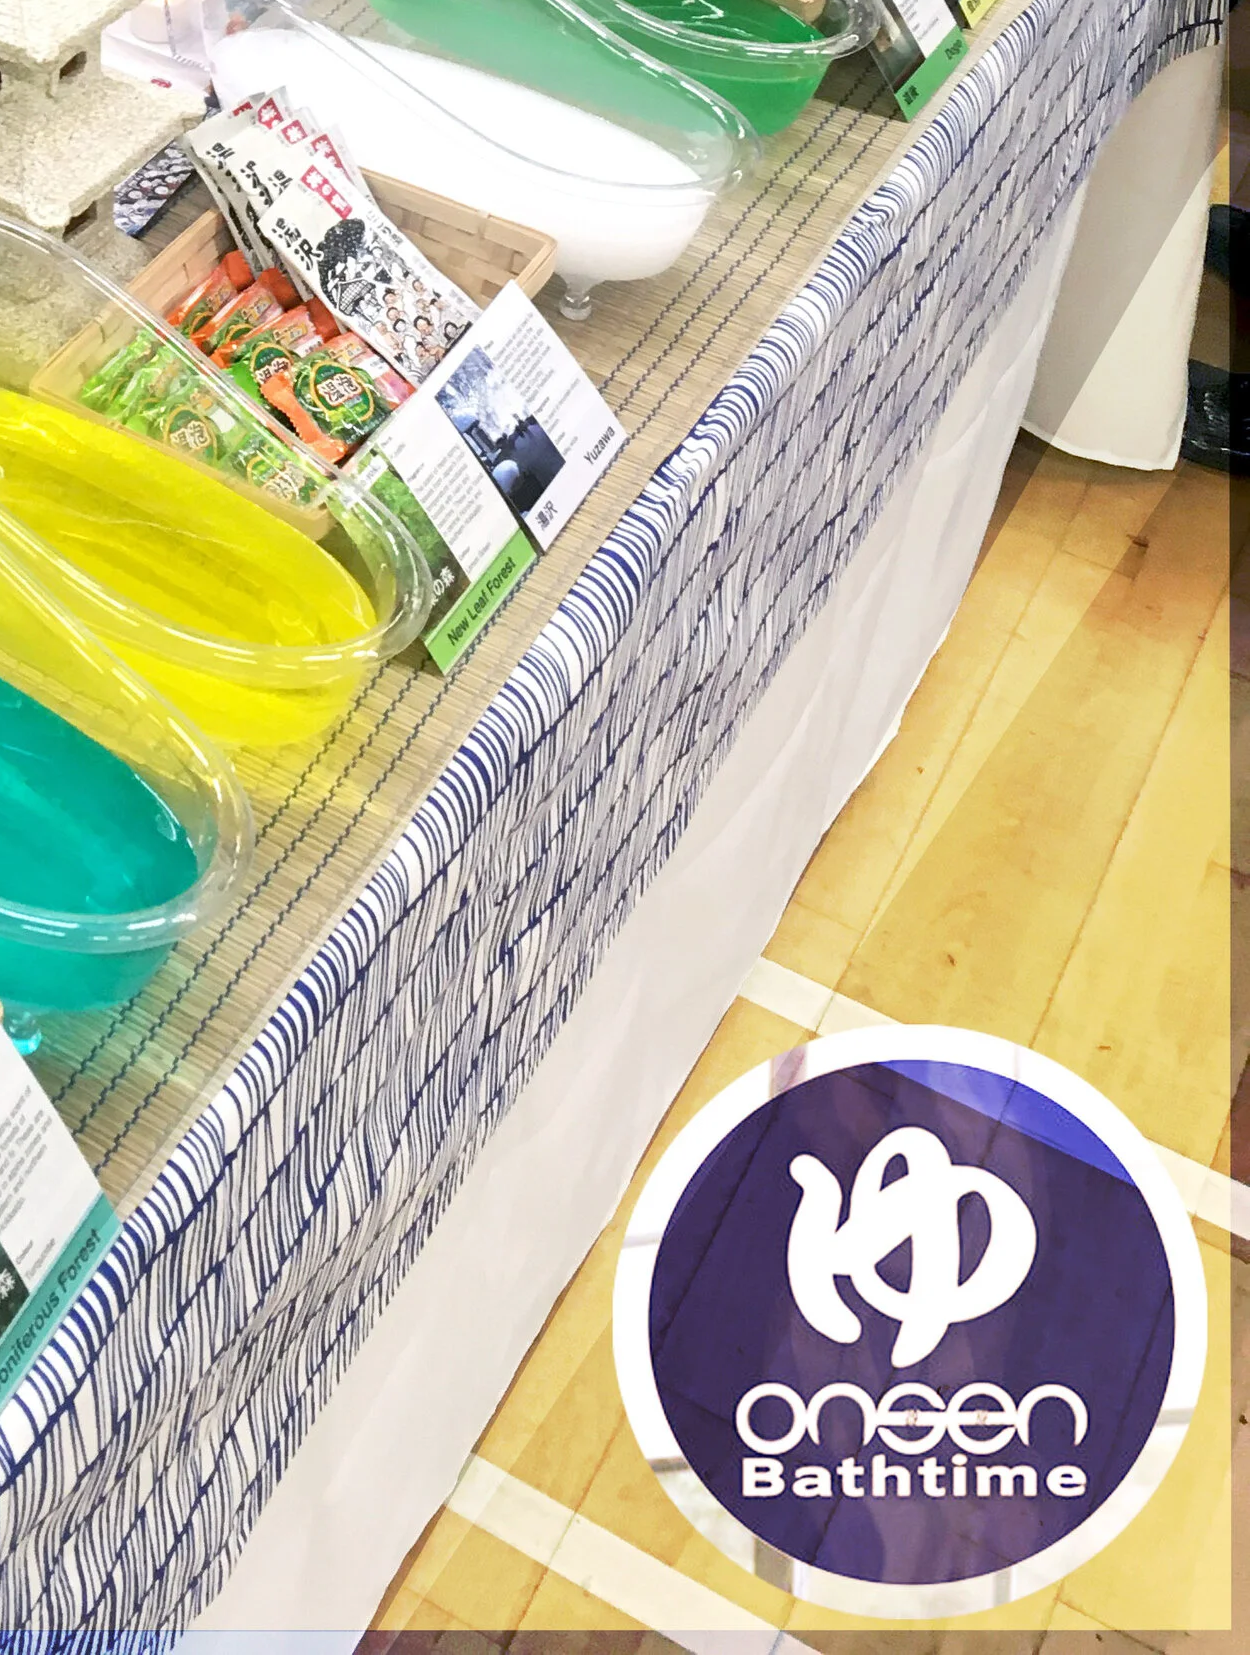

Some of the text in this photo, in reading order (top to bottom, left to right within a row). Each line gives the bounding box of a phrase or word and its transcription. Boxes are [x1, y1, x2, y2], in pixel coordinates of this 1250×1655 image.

[583, 425, 617, 467] Yuzawa
[447, 557, 517, 647] New Leaf Forest
[57, 1228, 102, 1294] Forest
